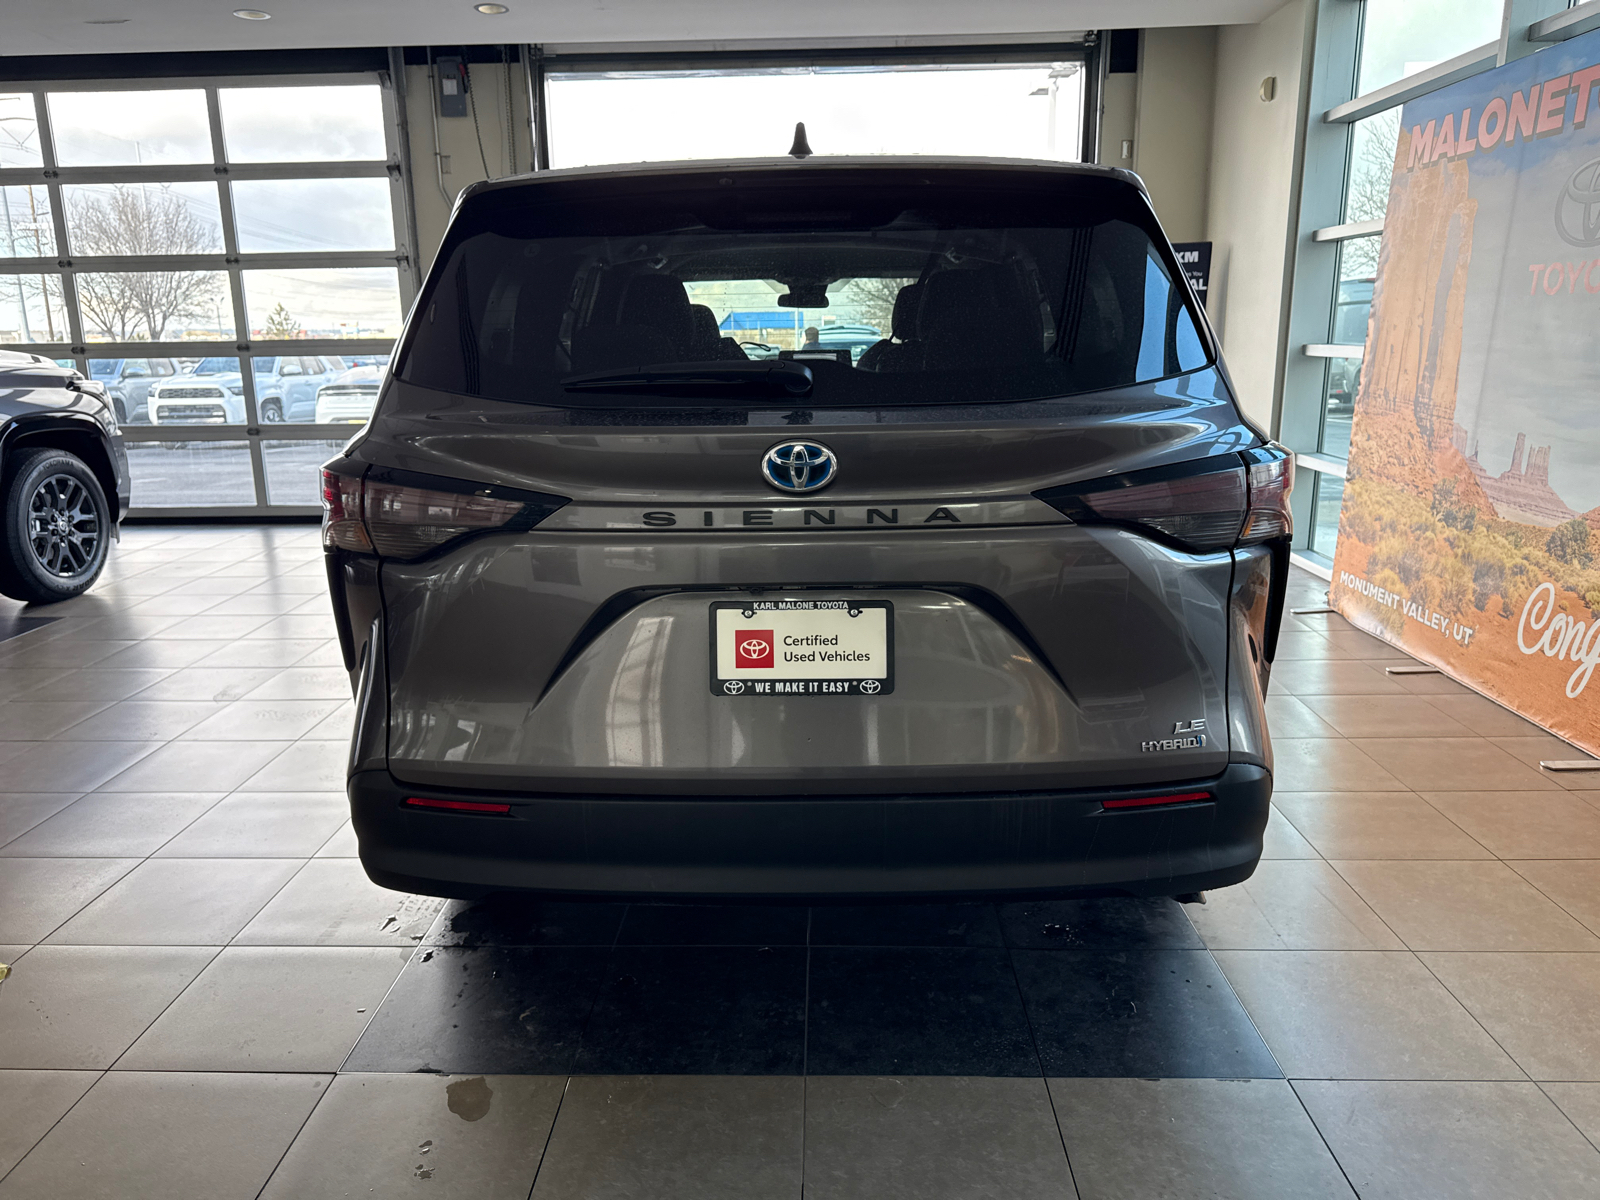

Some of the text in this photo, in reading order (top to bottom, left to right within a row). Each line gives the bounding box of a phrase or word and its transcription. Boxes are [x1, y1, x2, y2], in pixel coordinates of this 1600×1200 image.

[1406, 64, 1600, 172] MALONET
[1190, 279, 1208, 290] AL
[642, 507, 962, 527] SIENNA
[753, 601, 849, 610] KARL MALONE TOYOTA
[1339, 569, 1473, 645] MONUMENT VALLEY, UT
[783, 634, 838, 646] Certified
[783, 650, 871, 662] Used Vehicles
[755, 681, 850, 692] WE MAKE IT EASY
[1173, 718, 1206, 735] LE
[1141, 737, 1198, 752] HYBRID
